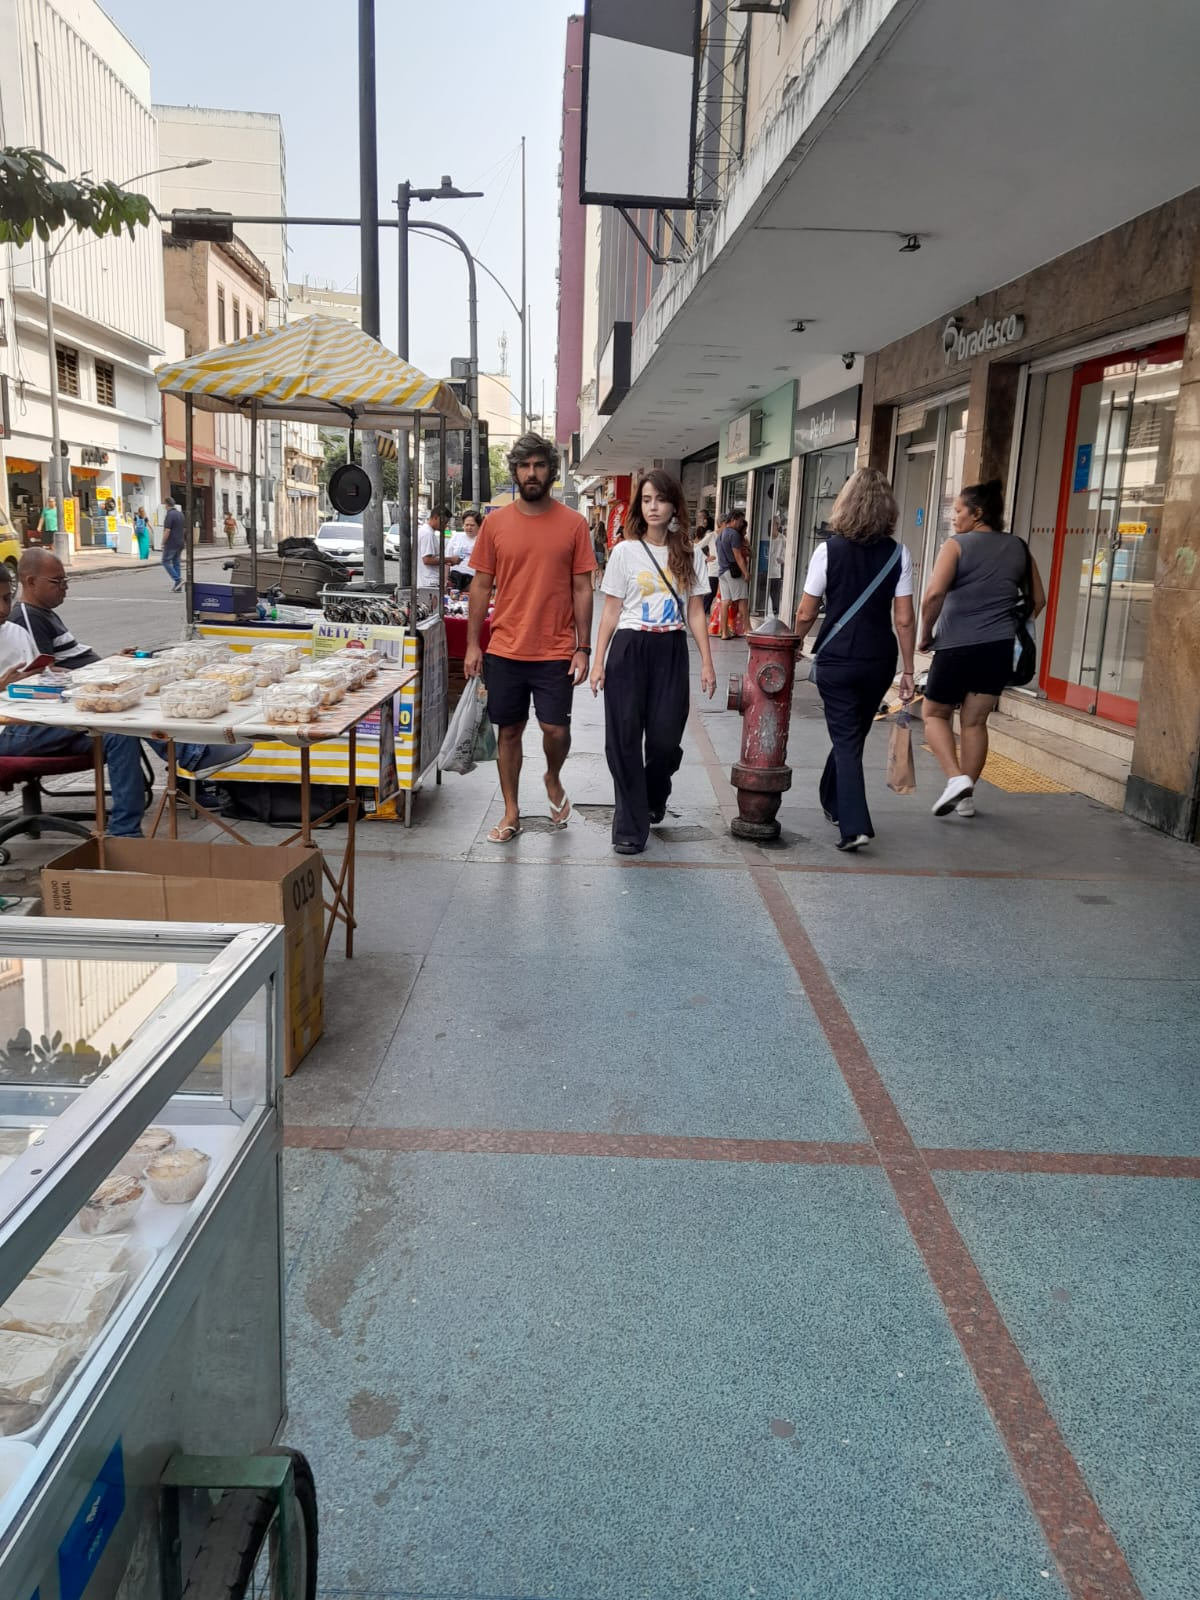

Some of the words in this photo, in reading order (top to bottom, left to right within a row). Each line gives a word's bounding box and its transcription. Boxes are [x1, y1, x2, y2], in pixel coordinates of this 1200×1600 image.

[957, 314, 1018, 361] bradesco
[51, 880, 61, 911] CUIDADO
[292, 868, 316, 912] 019
